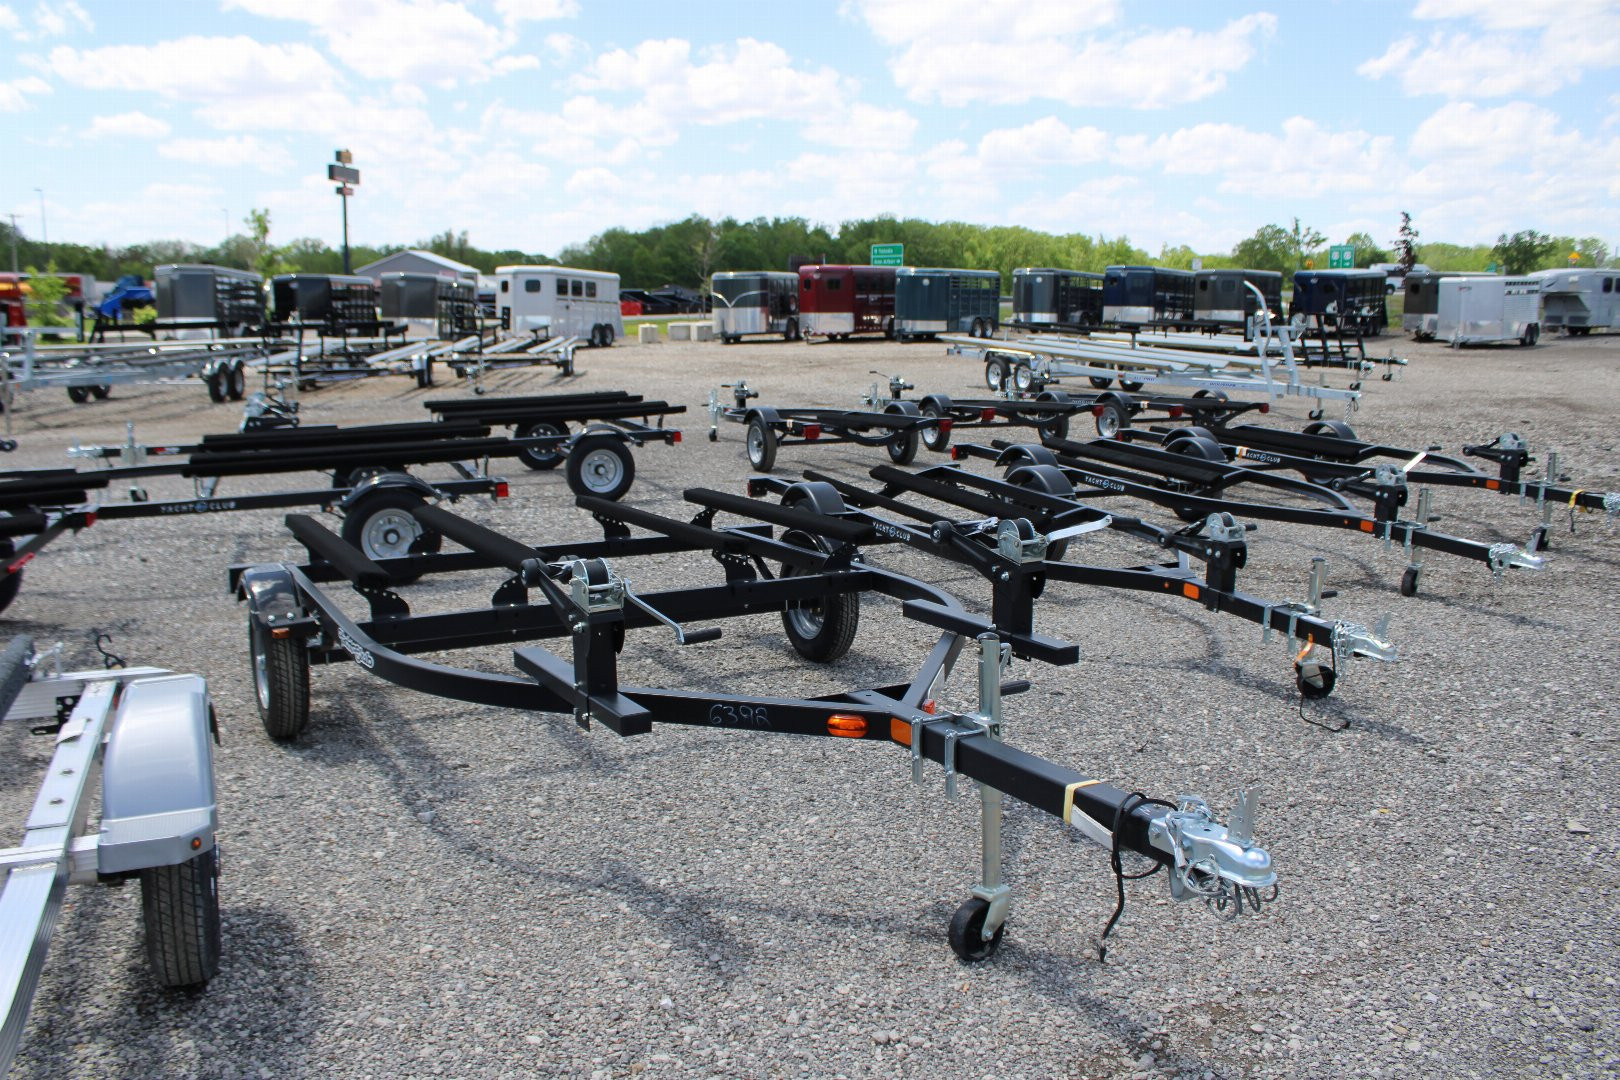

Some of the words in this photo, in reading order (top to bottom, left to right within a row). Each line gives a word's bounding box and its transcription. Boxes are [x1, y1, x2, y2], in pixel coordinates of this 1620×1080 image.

[1085, 475, 1103, 486] YACHT
[1110, 481, 1125, 492] CLUB
[160, 503, 194, 514] YACHT
[208, 500, 236, 511] CLUB
[872, 521, 890, 534] YACHT
[896, 529, 911, 542] CLUB
